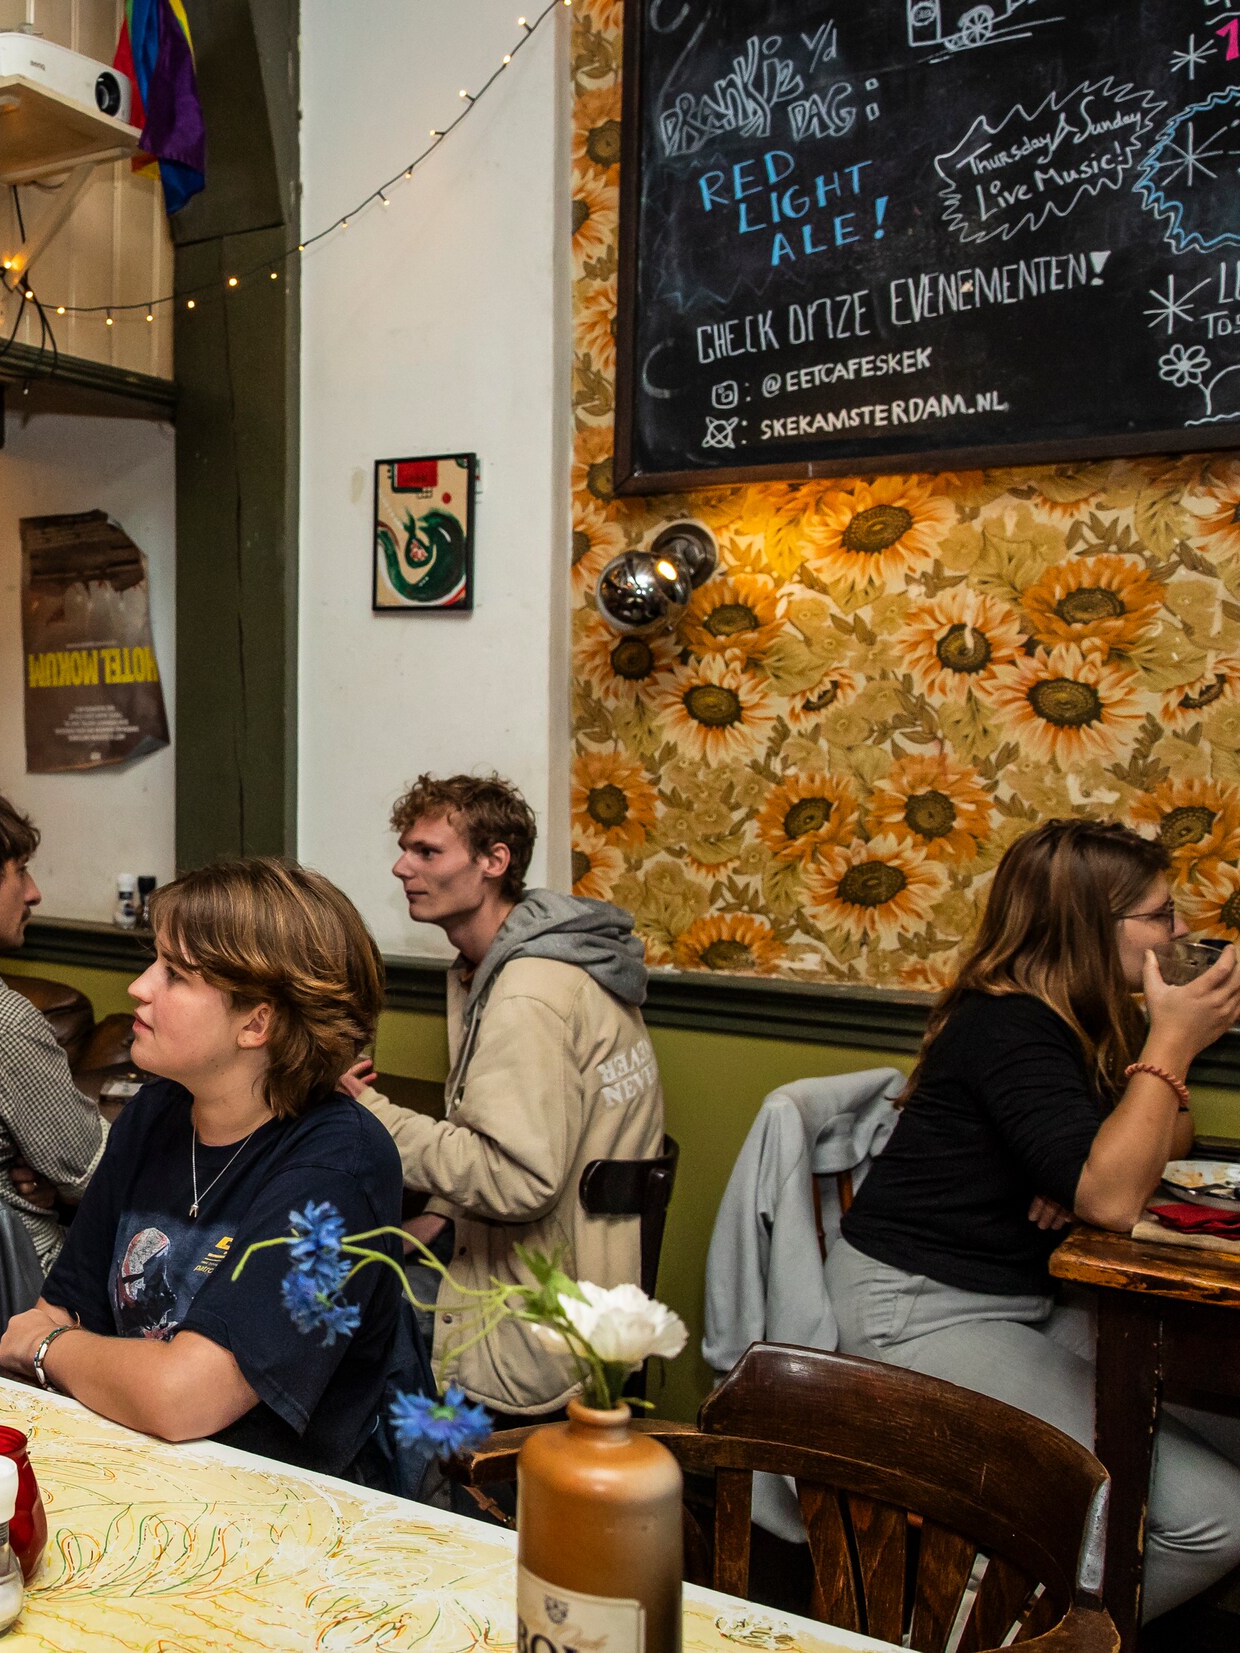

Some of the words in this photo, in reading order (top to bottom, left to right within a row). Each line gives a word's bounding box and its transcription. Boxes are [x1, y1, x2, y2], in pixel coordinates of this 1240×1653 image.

[1072, 95, 1142, 144] Sunday
[698, 150, 797, 213] RED
[738, 159, 873, 235] LIGHT
[975, 180, 1033, 222] Live
[1033, 140, 1123, 192] Music!
[770, 195, 890, 267] ALE!
[696, 309, 781, 365] CHECK
[889, 249, 1112, 326] EVENEMENTEN!
[761, 346, 933, 398] @EETCAFESKEK
[760, 390, 1006, 441] SKEKAMSTERDAM.NL
